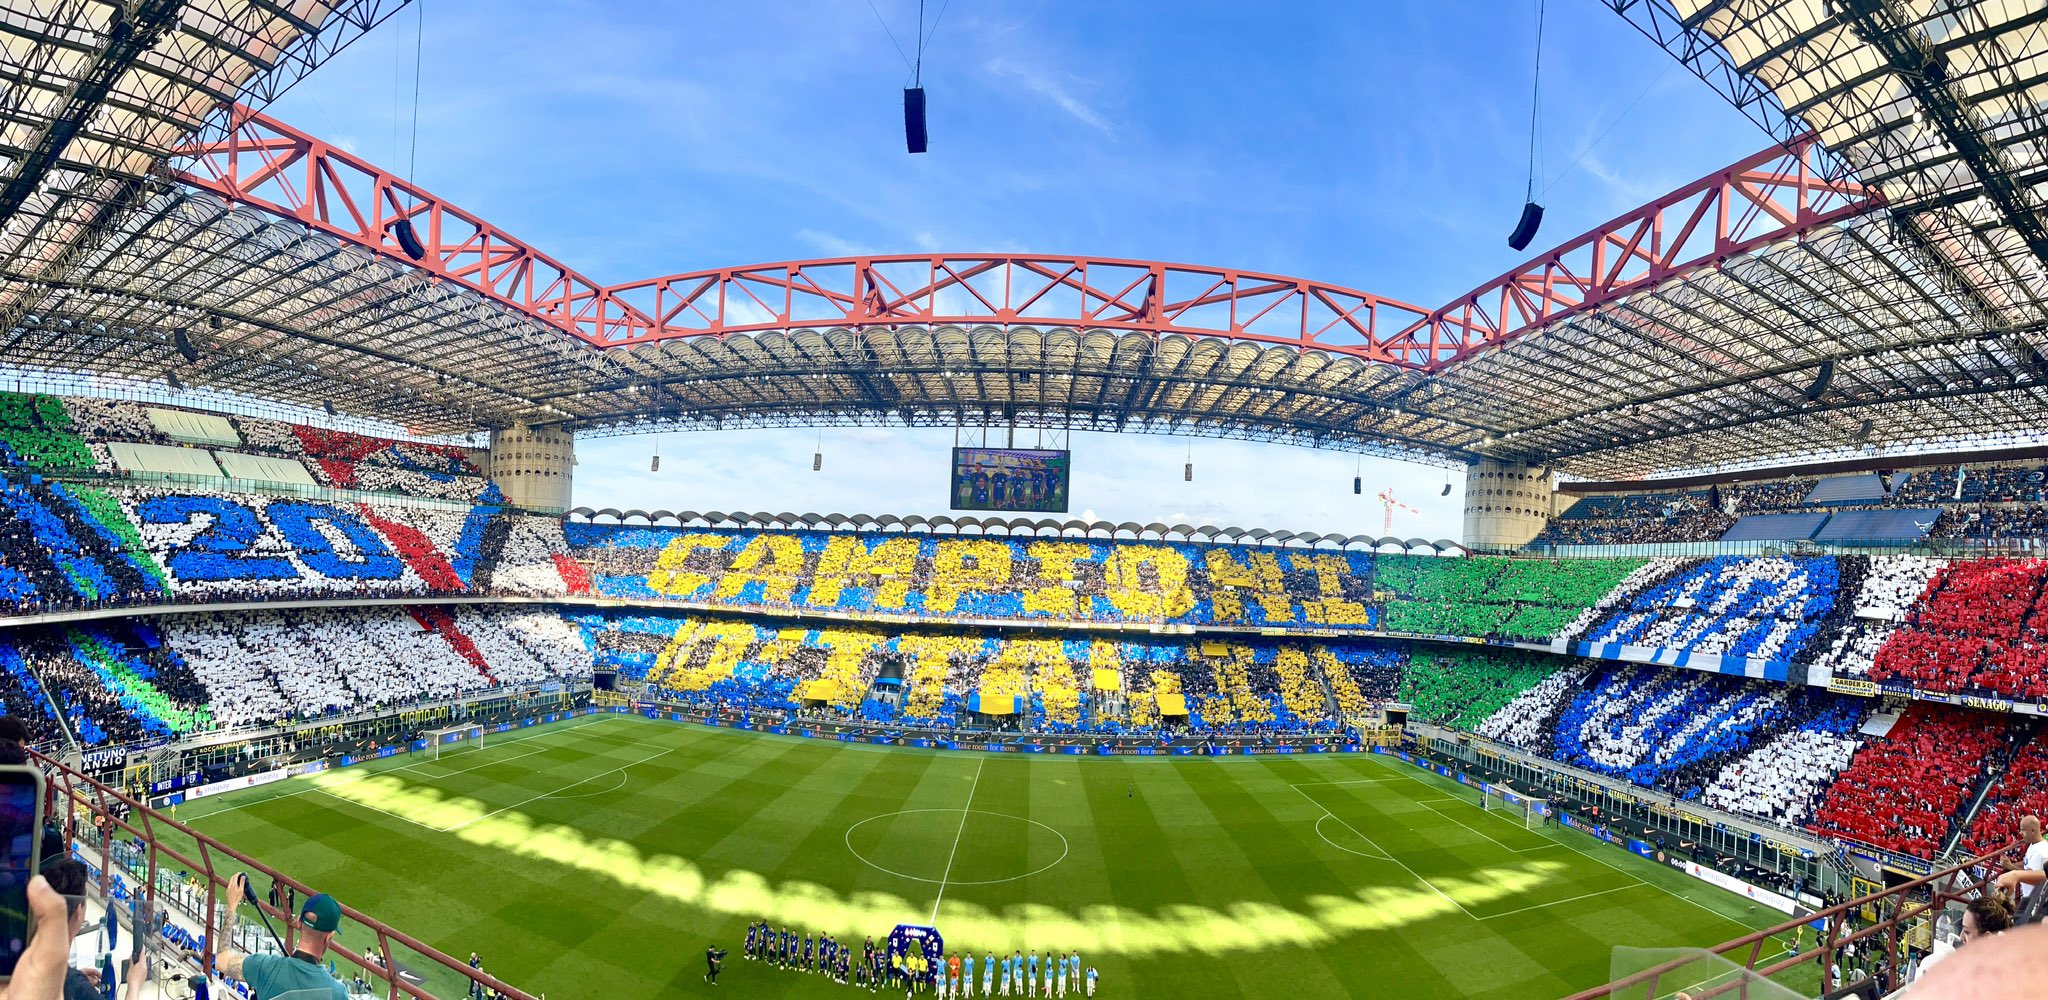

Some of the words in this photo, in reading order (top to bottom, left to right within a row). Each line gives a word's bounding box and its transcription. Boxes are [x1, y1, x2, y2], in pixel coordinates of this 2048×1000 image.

[138, 495, 405, 580] 20
[647, 532, 1370, 626] CAMPIONI
[1967, 696, 2006, 711] SENAGO
[808, 730, 824, 739] Make
[954, 742, 971, 750] Make
[989, 742, 998, 751] for
[999, 744, 1017, 752] more.
[1106, 747, 1122, 755] Make
[1141, 747, 1150, 755] for
[1249, 747, 1264, 755] Make
[1280, 746, 1288, 754] for
[82, 748, 126, 763] NETTUNO
[348, 753, 366, 765] Make
[366, 751, 381, 762] room
[382, 749, 391, 759] for
[392, 746, 407, 757] more.
[83, 756, 122, 772] ANZIO
[255, 770, 279, 783] snaipay
[157, 779, 172, 791] INTER
[203, 782, 229, 794] snaipay
[1566, 815, 1582, 830] Make
[1583, 824, 1596, 835] room
[1702, 868, 1728, 886] snaipay
[1756, 890, 1784, 908] snaipay
